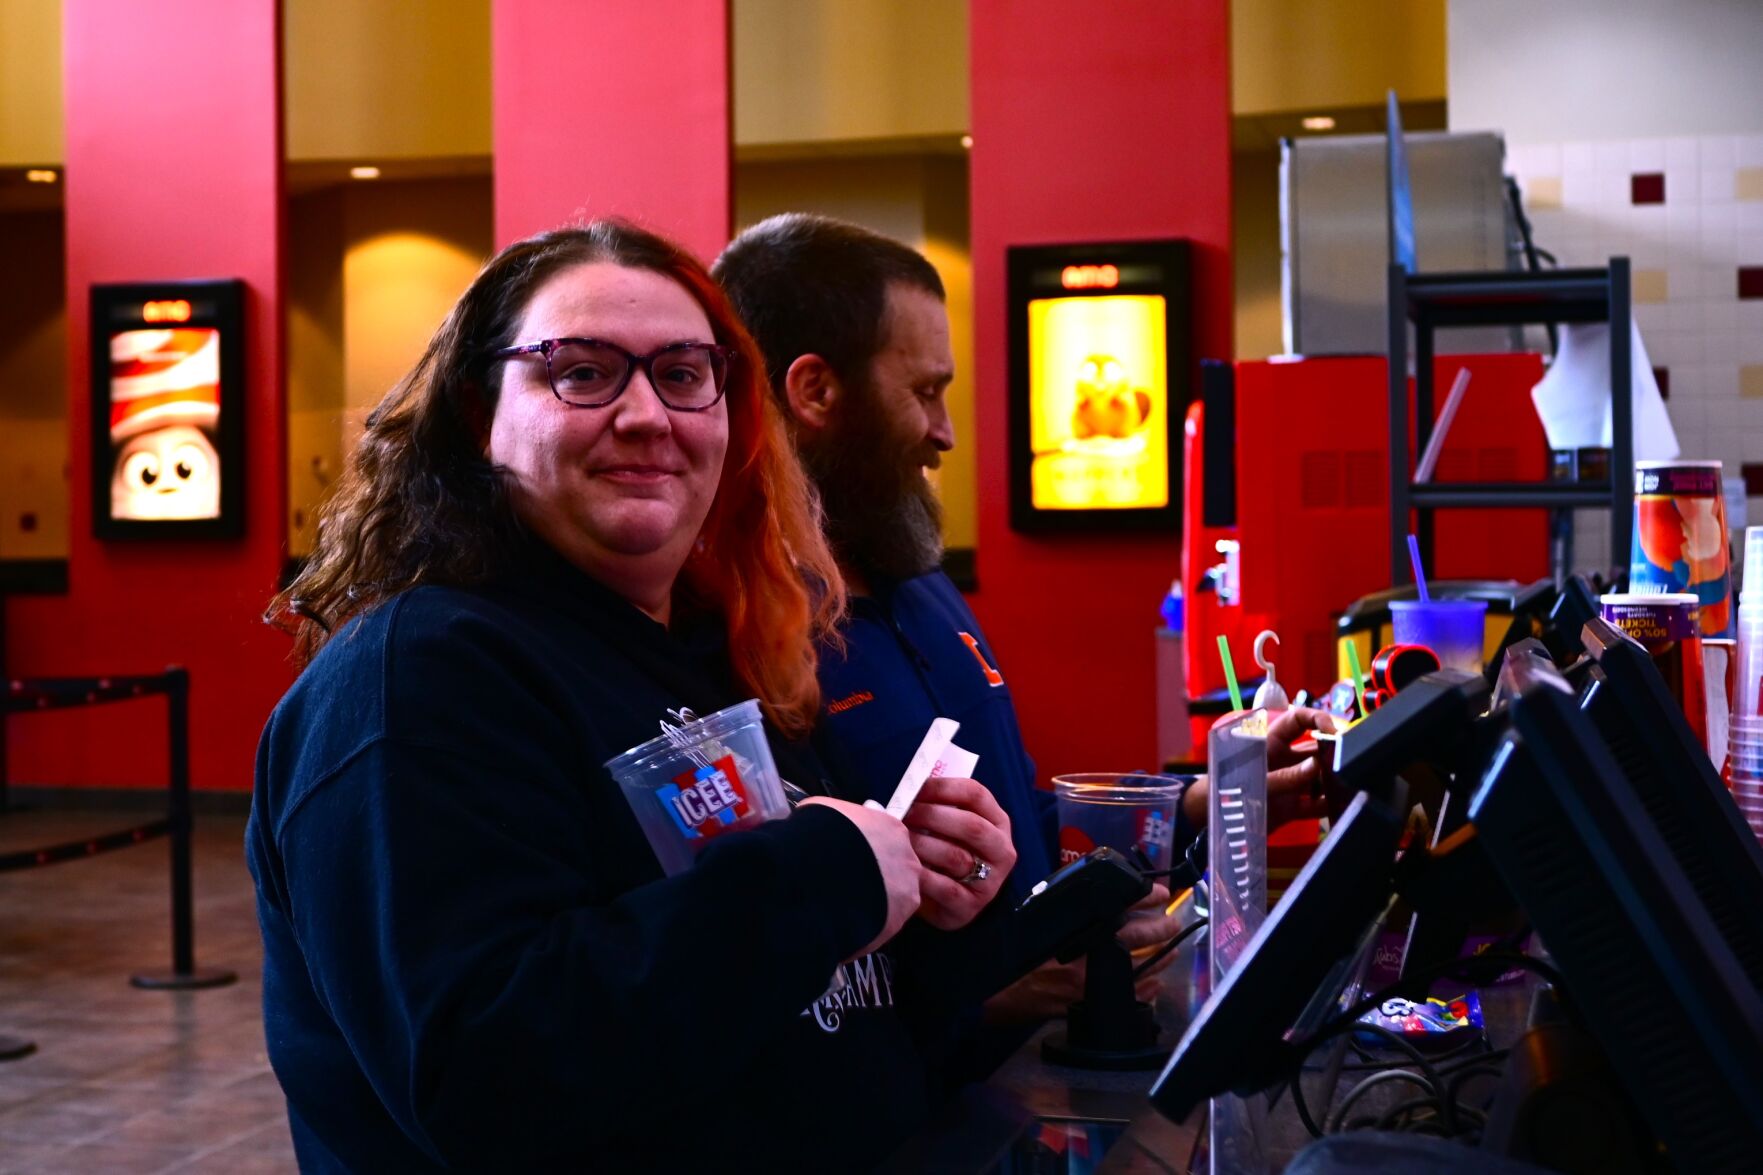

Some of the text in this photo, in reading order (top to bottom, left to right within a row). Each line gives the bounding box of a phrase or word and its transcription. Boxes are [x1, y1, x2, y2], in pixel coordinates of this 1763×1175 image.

[1624, 627, 1668, 639] 50% OF
[957, 631, 1004, 687] I
[671, 768, 741, 828] ICEE
[1061, 847, 1087, 863] am
